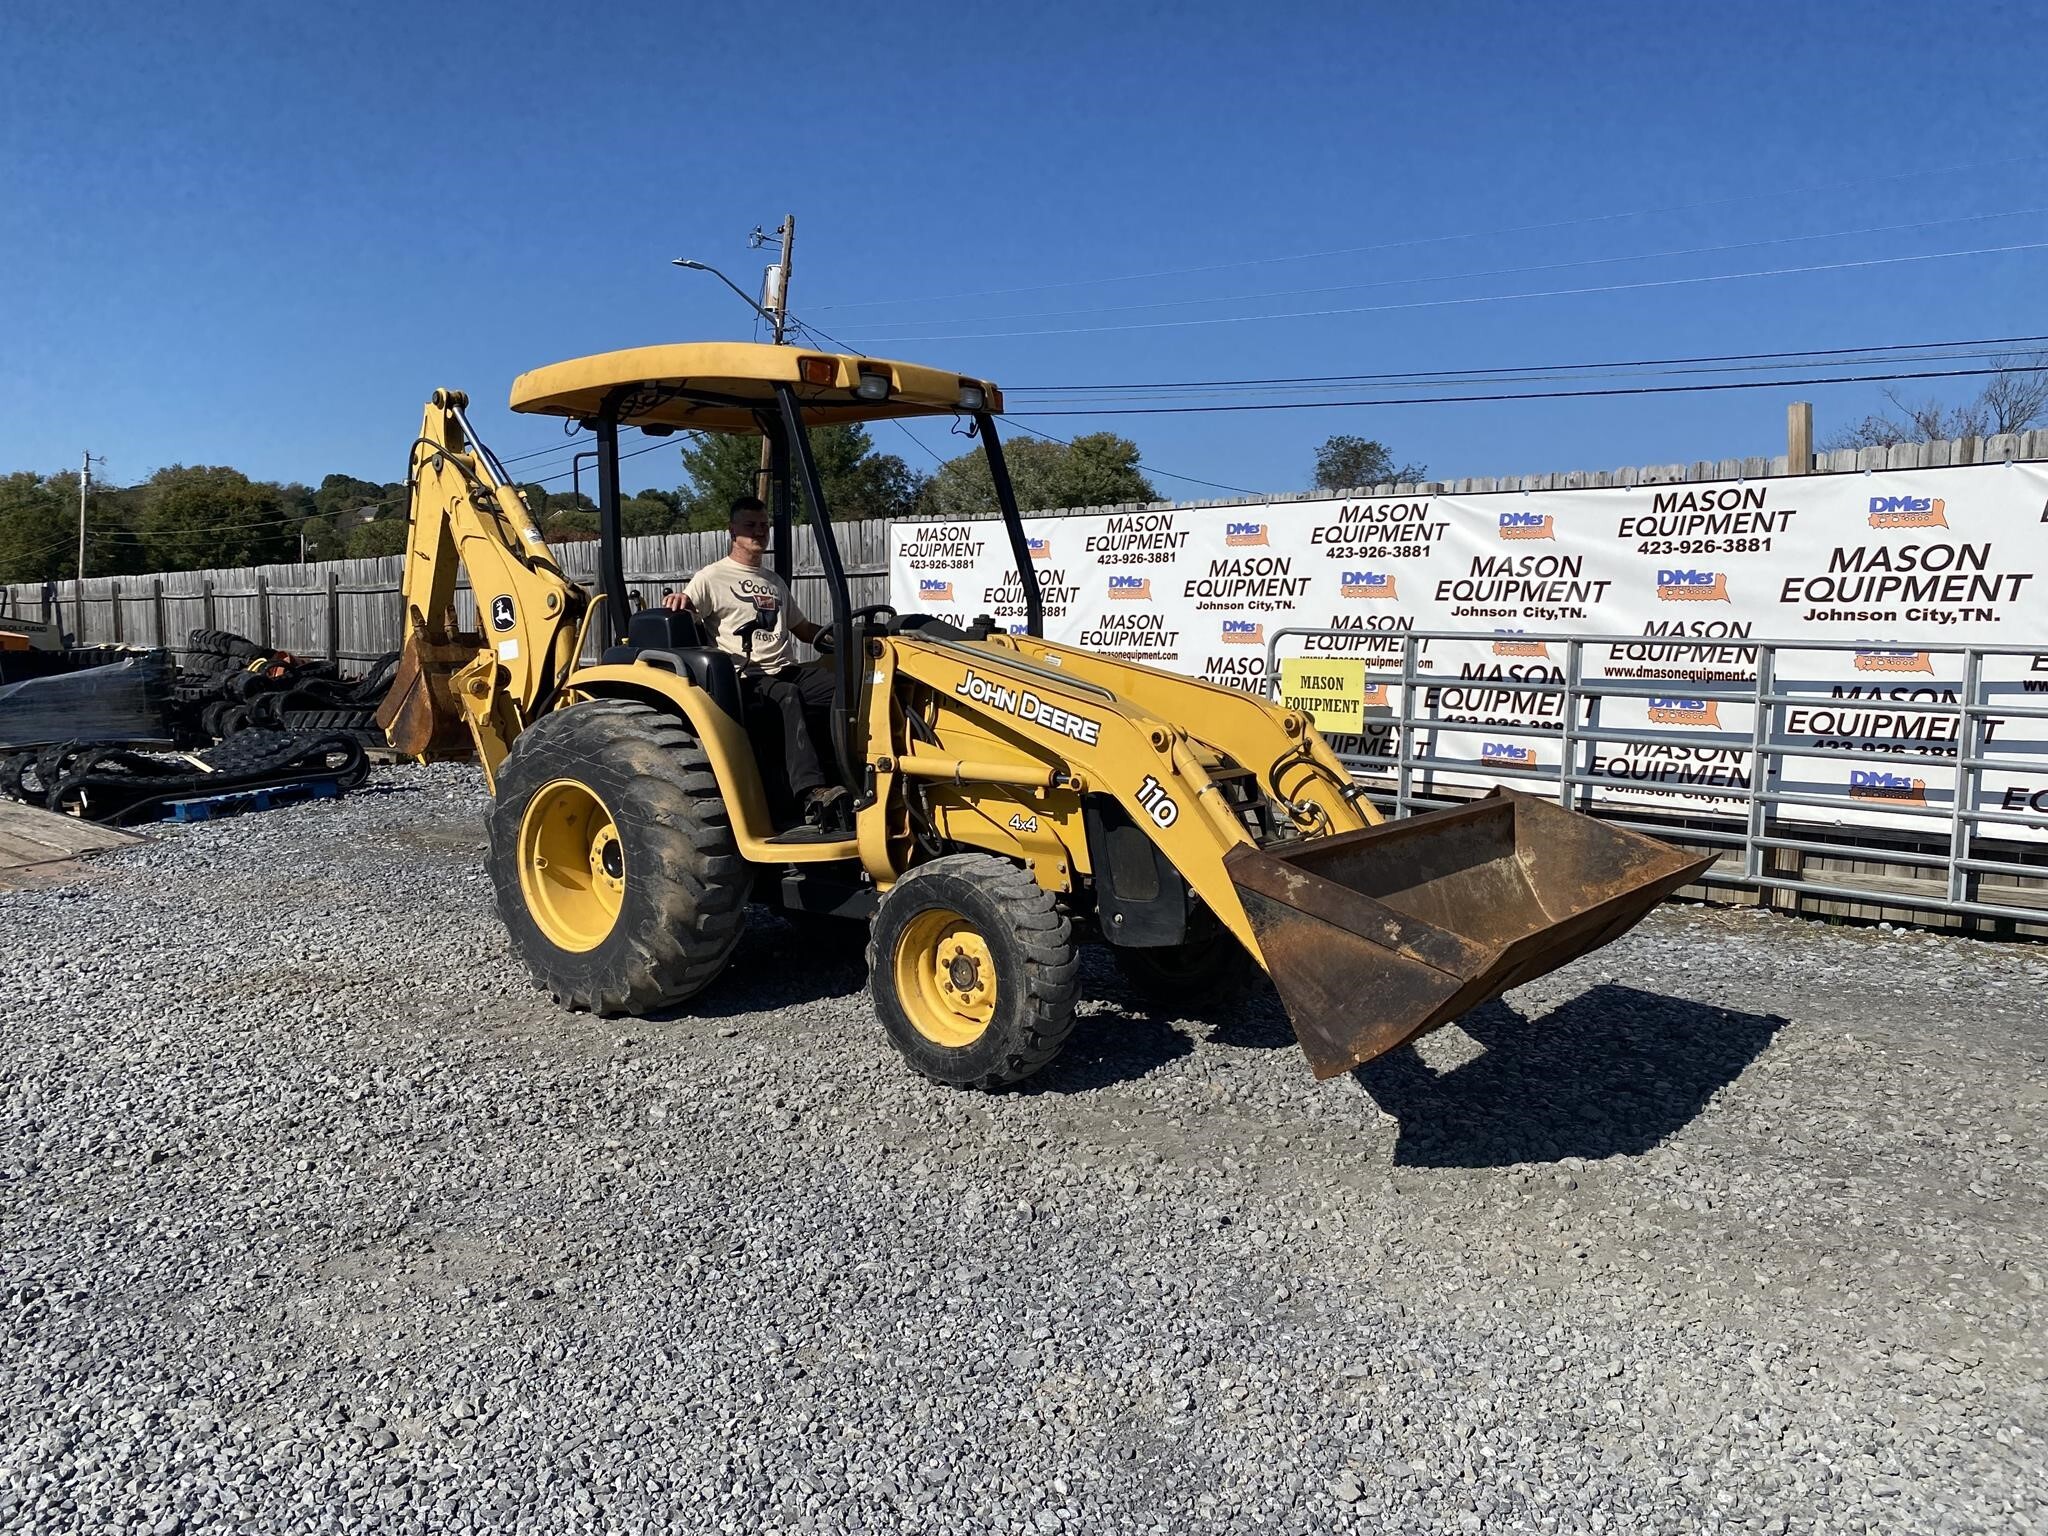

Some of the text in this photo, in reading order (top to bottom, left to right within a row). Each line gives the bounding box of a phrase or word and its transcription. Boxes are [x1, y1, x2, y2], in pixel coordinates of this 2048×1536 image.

[1652, 487, 1767, 513] MASON
[1339, 503, 1429, 523] MASON
[1106, 515, 1173, 534] MASON
[1618, 510, 1796, 538] EQUIPMENT
[916, 527, 971, 542] MASON
[1086, 531, 1189, 551] EQUIPMENT
[1311, 522, 1450, 545] EQUIPMENT
[899, 542, 985, 557] EQUIPMENT
[1326, 545, 1430, 558] 423-926-3881
[1637, 537, 1772, 555] 423-926-3881
[909, 560, 975, 569] 423-926-3881
[1097, 552, 1176, 565] 423-926-3881
[1209, 557, 1292, 577] MASON
[1470, 556, 1582, 578] MASON
[1828, 543, 1991, 573] MASON
[1003, 569, 1066, 586] MON
[1184, 578, 1311, 597] EQUIPMENT
[1435, 580, 1611, 602] EQUIPMENT
[1780, 574, 2033, 602] EQUIPMENT
[994, 607, 1067, 617] 423-923881
[1196, 600, 1296, 612] Johnson City,TN.
[1451, 606, 1587, 620] Johnson City,TN.
[1099, 614, 1164, 630] MASON
[1331, 615, 1414, 631] MASON
[1804, 608, 2000, 624] Johnson City,TN.
[1079, 631, 1179, 647] EQUIPMENT
[1643, 621, 1752, 639] MASON
[1097, 649, 1178, 661] asonequipment.com
[1609, 643, 1758, 665] EQUIPMEN
[1604, 665, 1757, 683] www.dmasonequipment.c
[1300, 676, 1344, 691] MASON
[956, 669, 1101, 746] JOHN DEERE
[1285, 697, 1359, 713] EQUIPMENT
[1588, 756, 1752, 789] EQUIPMEN
[1135, 775, 1179, 829] 110
[1009, 814, 1037, 832] 4x4
